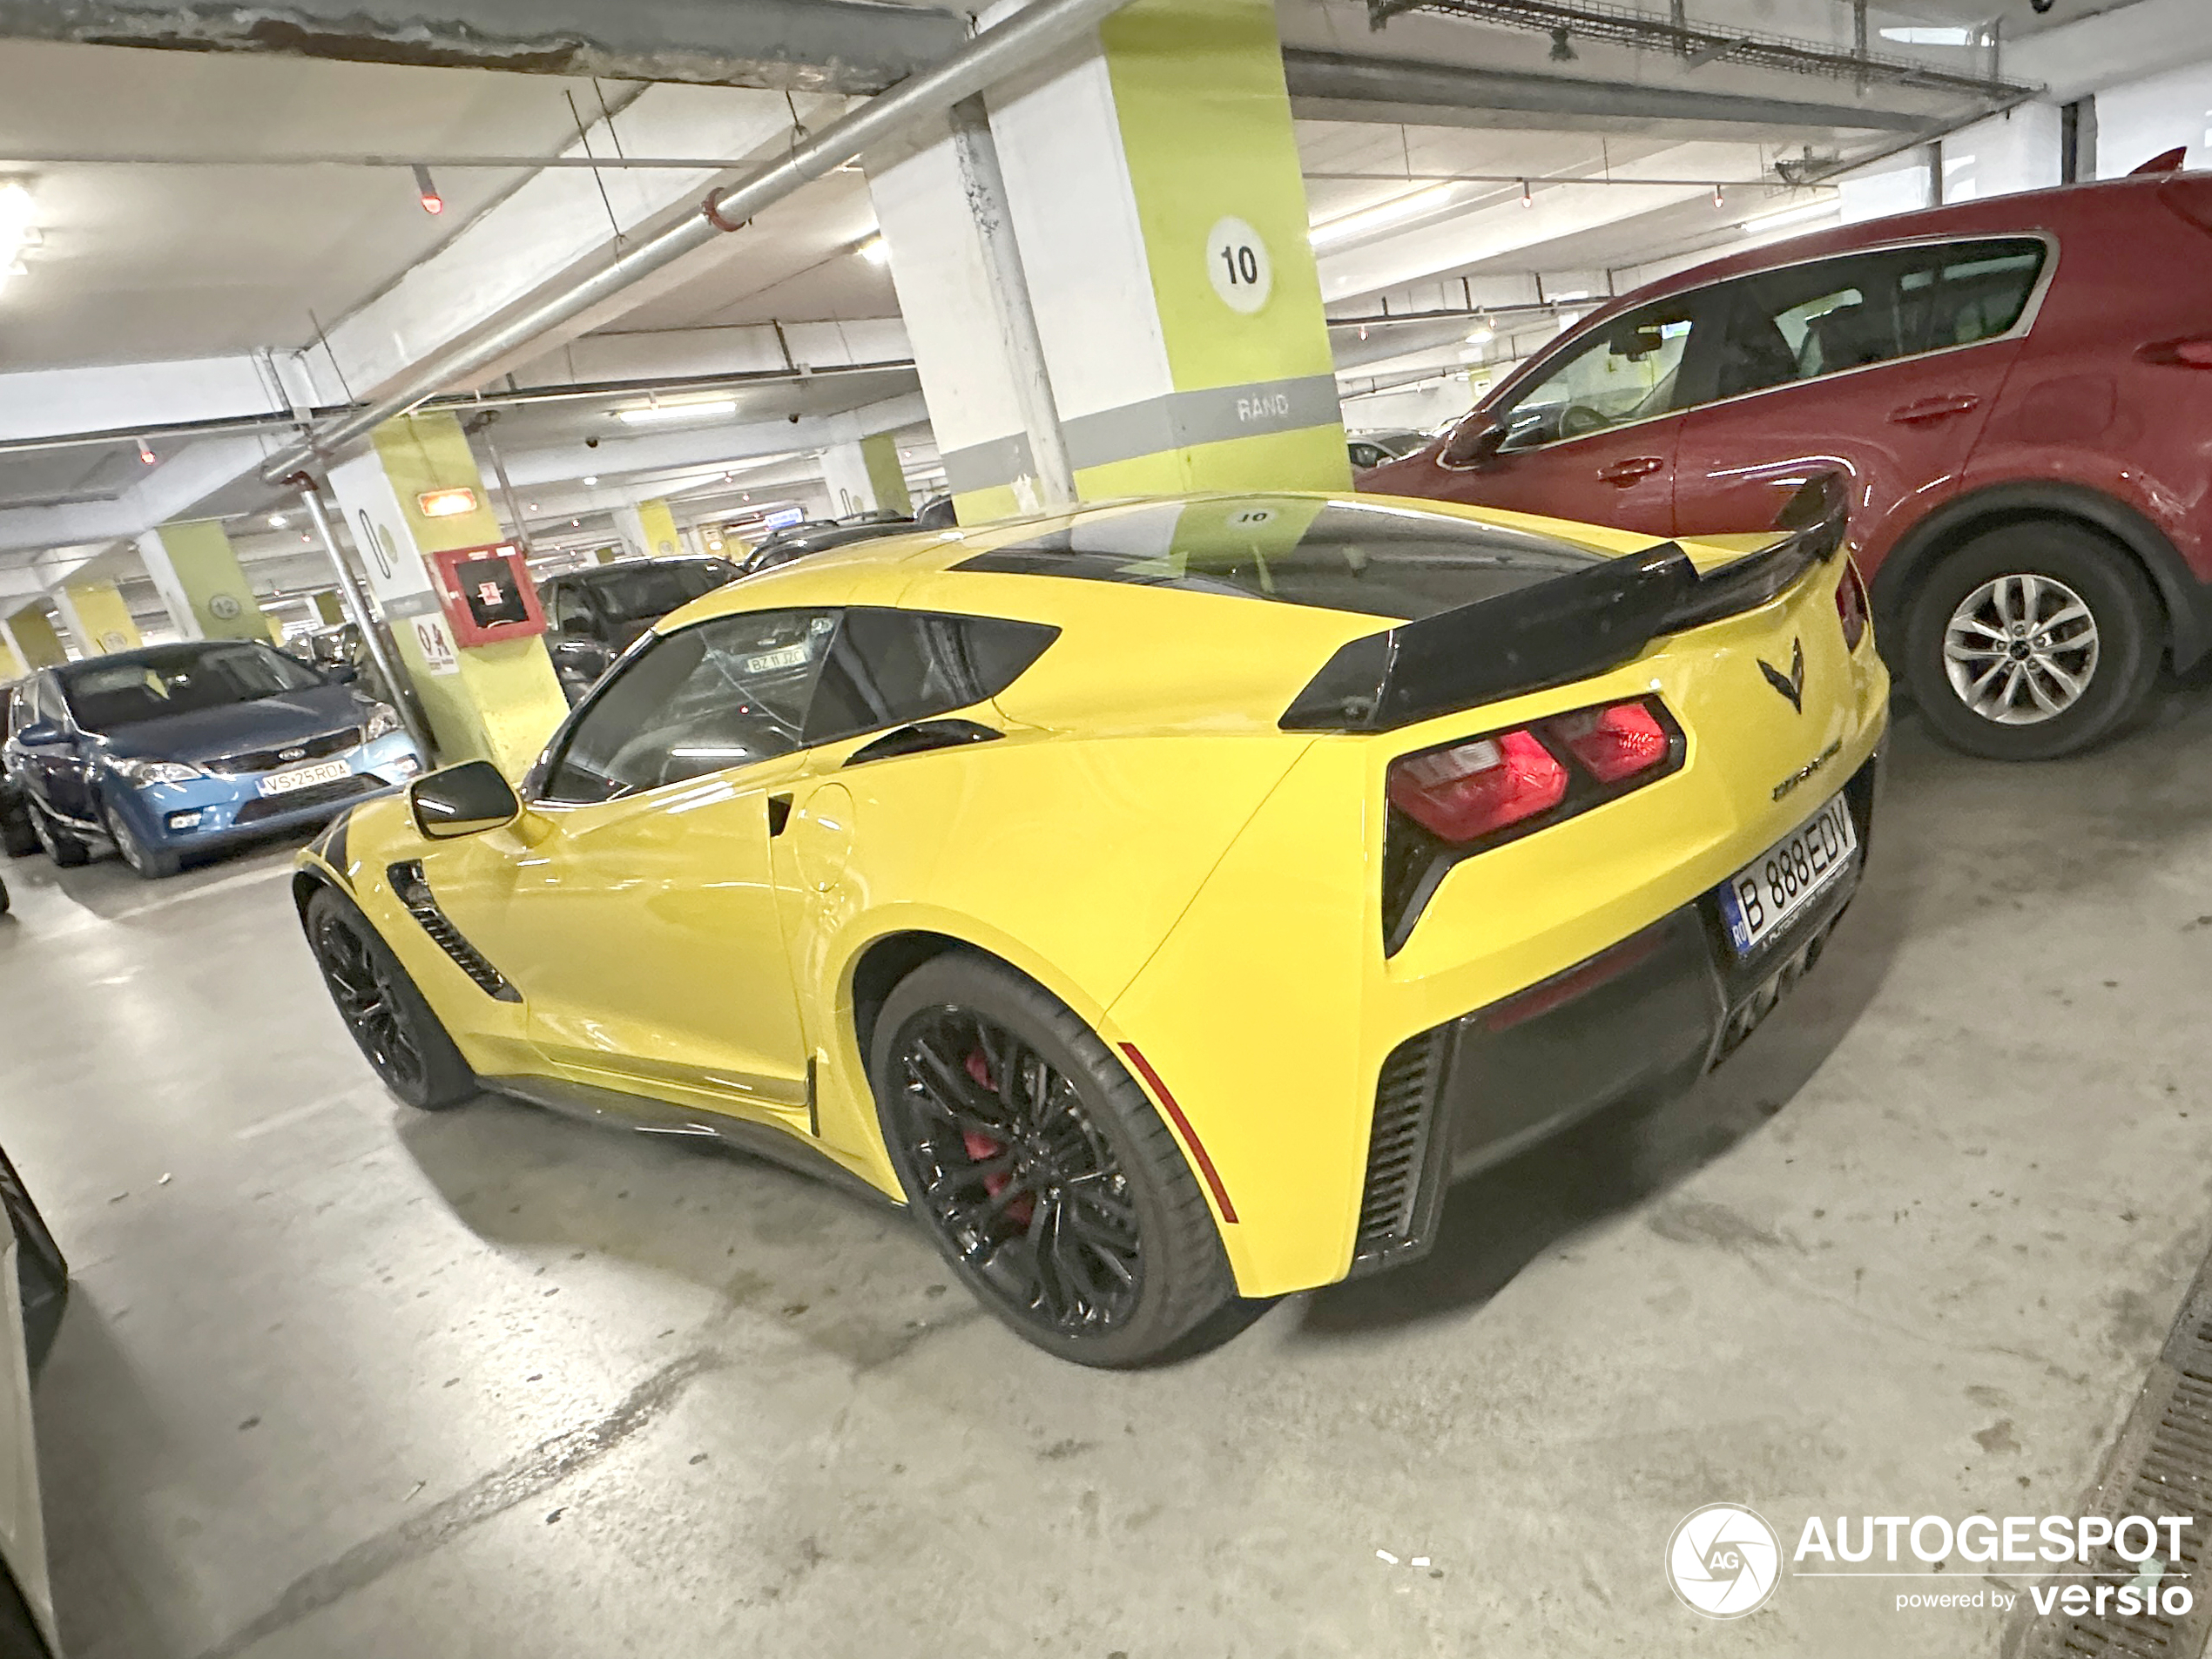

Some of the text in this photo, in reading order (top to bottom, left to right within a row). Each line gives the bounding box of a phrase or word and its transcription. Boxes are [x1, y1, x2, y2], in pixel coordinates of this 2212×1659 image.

[1221, 246, 1258, 285] 10
[1739, 878, 1764, 934] B
[1732, 921, 1748, 948] RO
